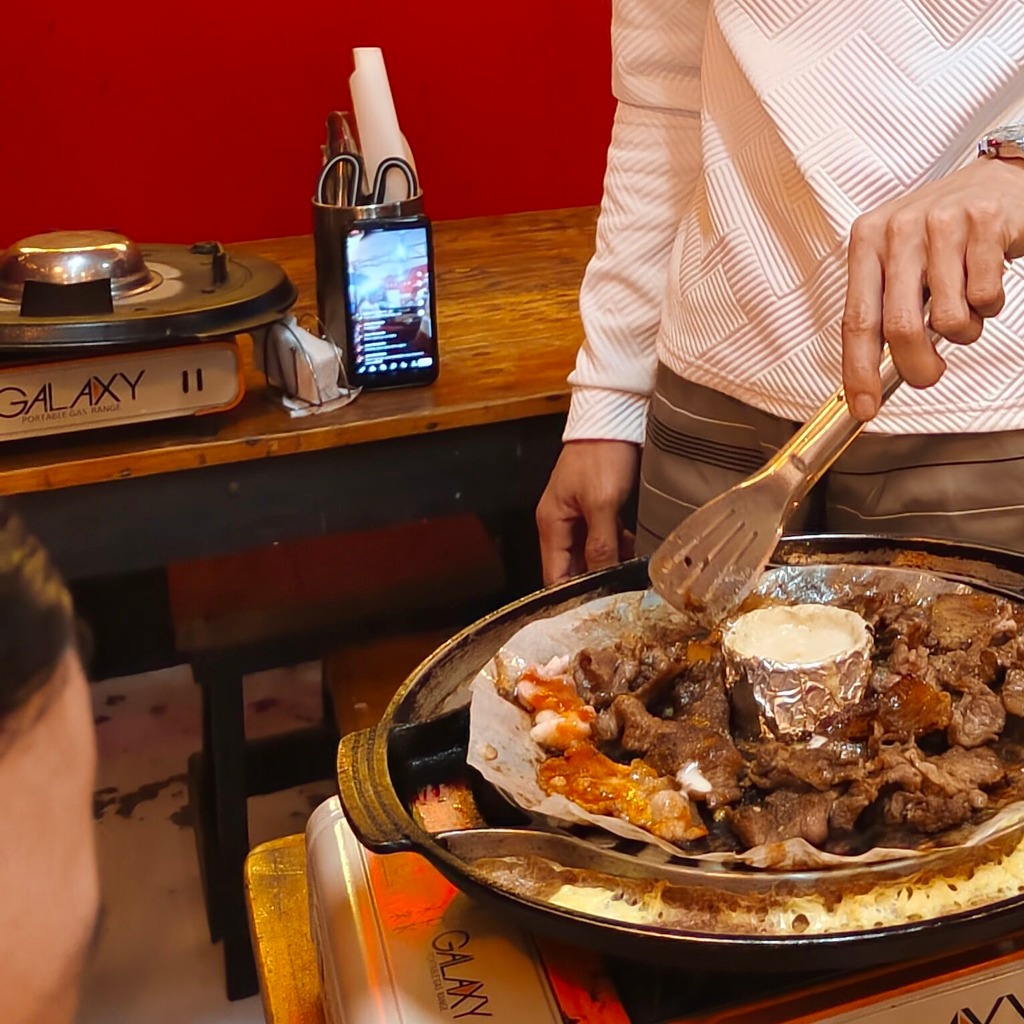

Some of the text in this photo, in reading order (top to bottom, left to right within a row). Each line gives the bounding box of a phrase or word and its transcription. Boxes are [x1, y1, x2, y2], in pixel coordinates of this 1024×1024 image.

[0, 370, 146, 418] GALAXY
[68, 407, 88, 418] GAS
[431, 929, 493, 1020] GALAXY
